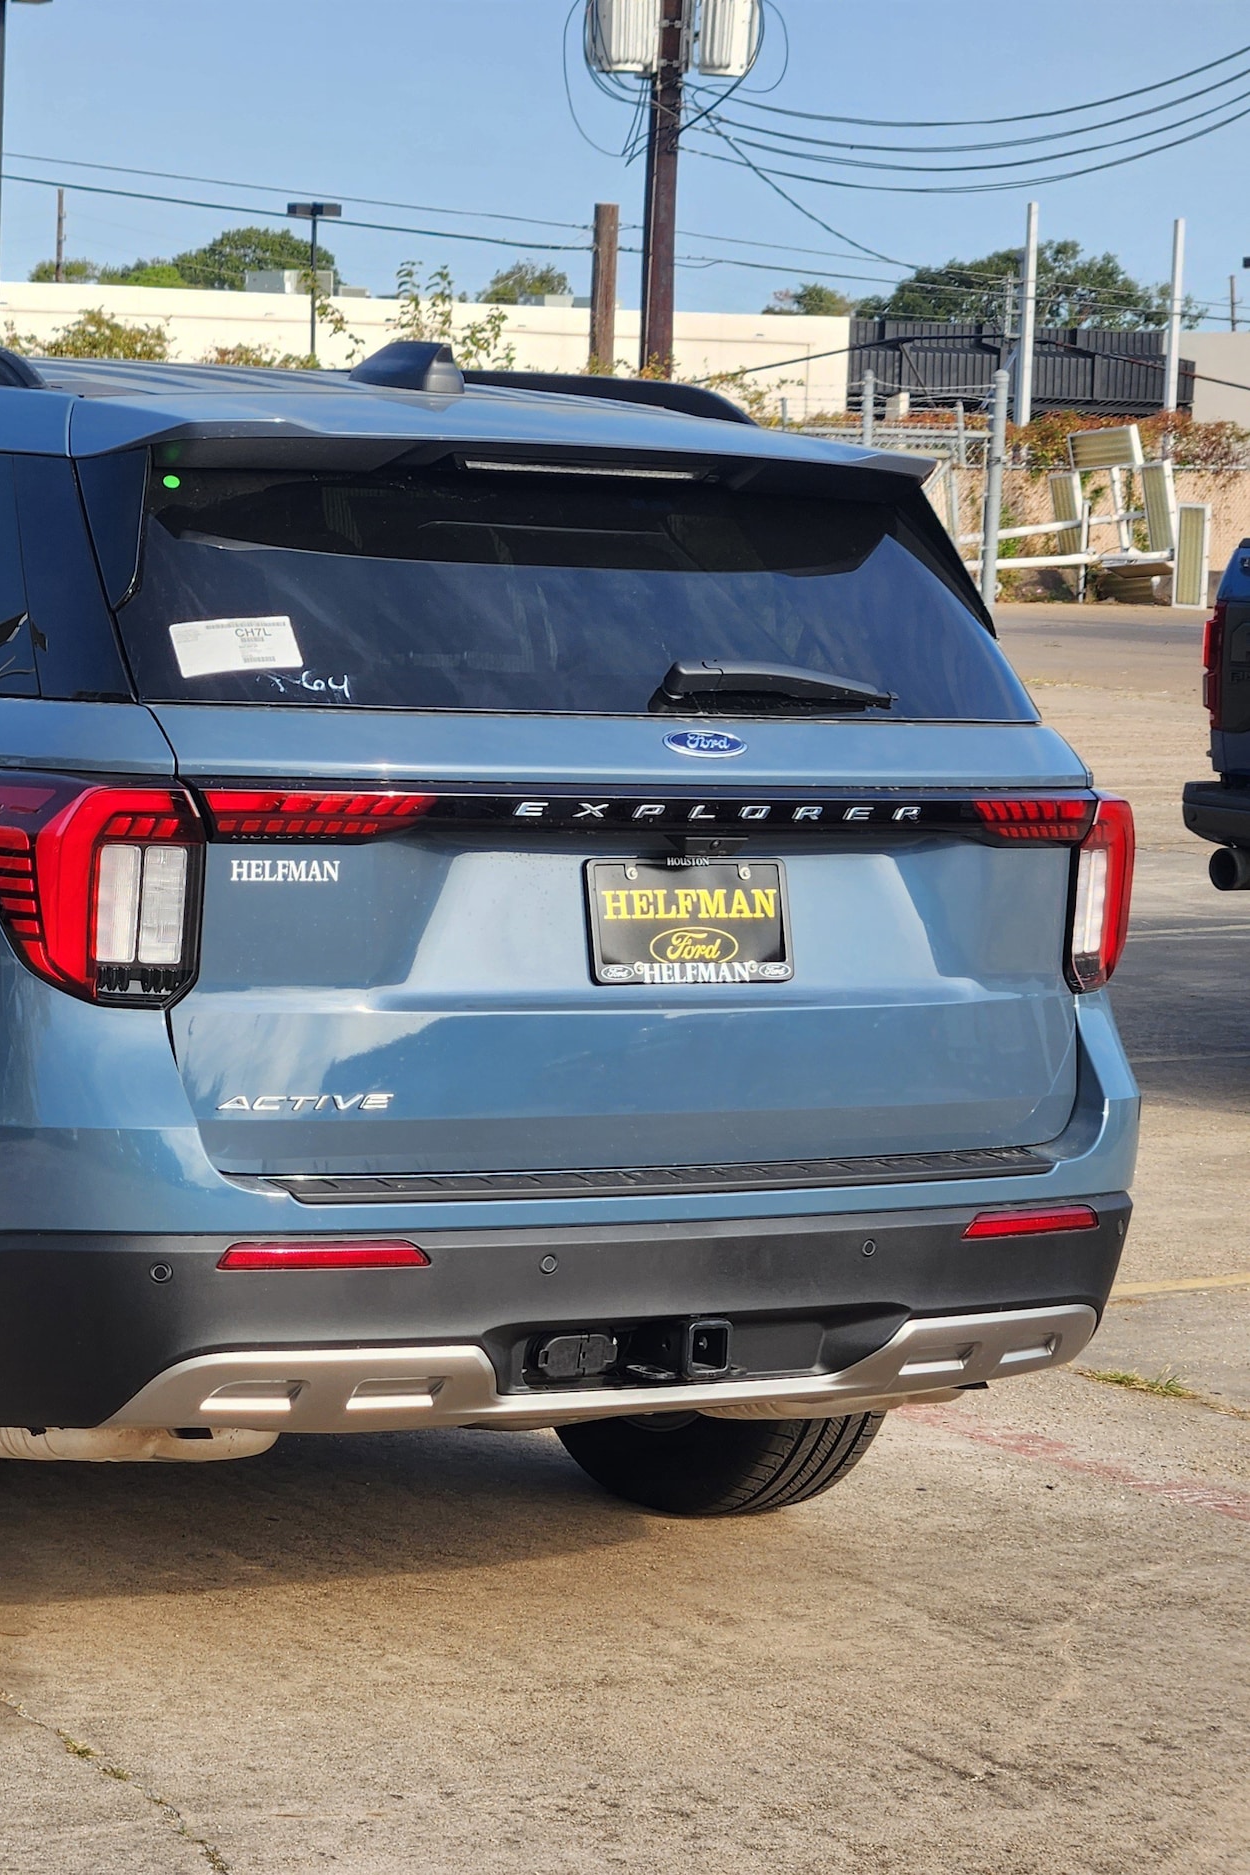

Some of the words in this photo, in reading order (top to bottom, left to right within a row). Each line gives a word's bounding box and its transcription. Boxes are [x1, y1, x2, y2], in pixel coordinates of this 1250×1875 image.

[234, 627, 273, 639] CH7L
[685, 732, 731, 751] Ford
[512, 801, 926, 822] EXPLORER
[230, 859, 341, 882] HELFMAN
[667, 855, 710, 867] HOUSTON
[601, 887, 777, 921] HELFMAN
[665, 931, 722, 963] Ford
[605, 965, 632, 978] Ford
[642, 962, 752, 984] HELFMAN
[763, 964, 788, 976] Ford
[216, 1093, 395, 1111] ACTIVE
